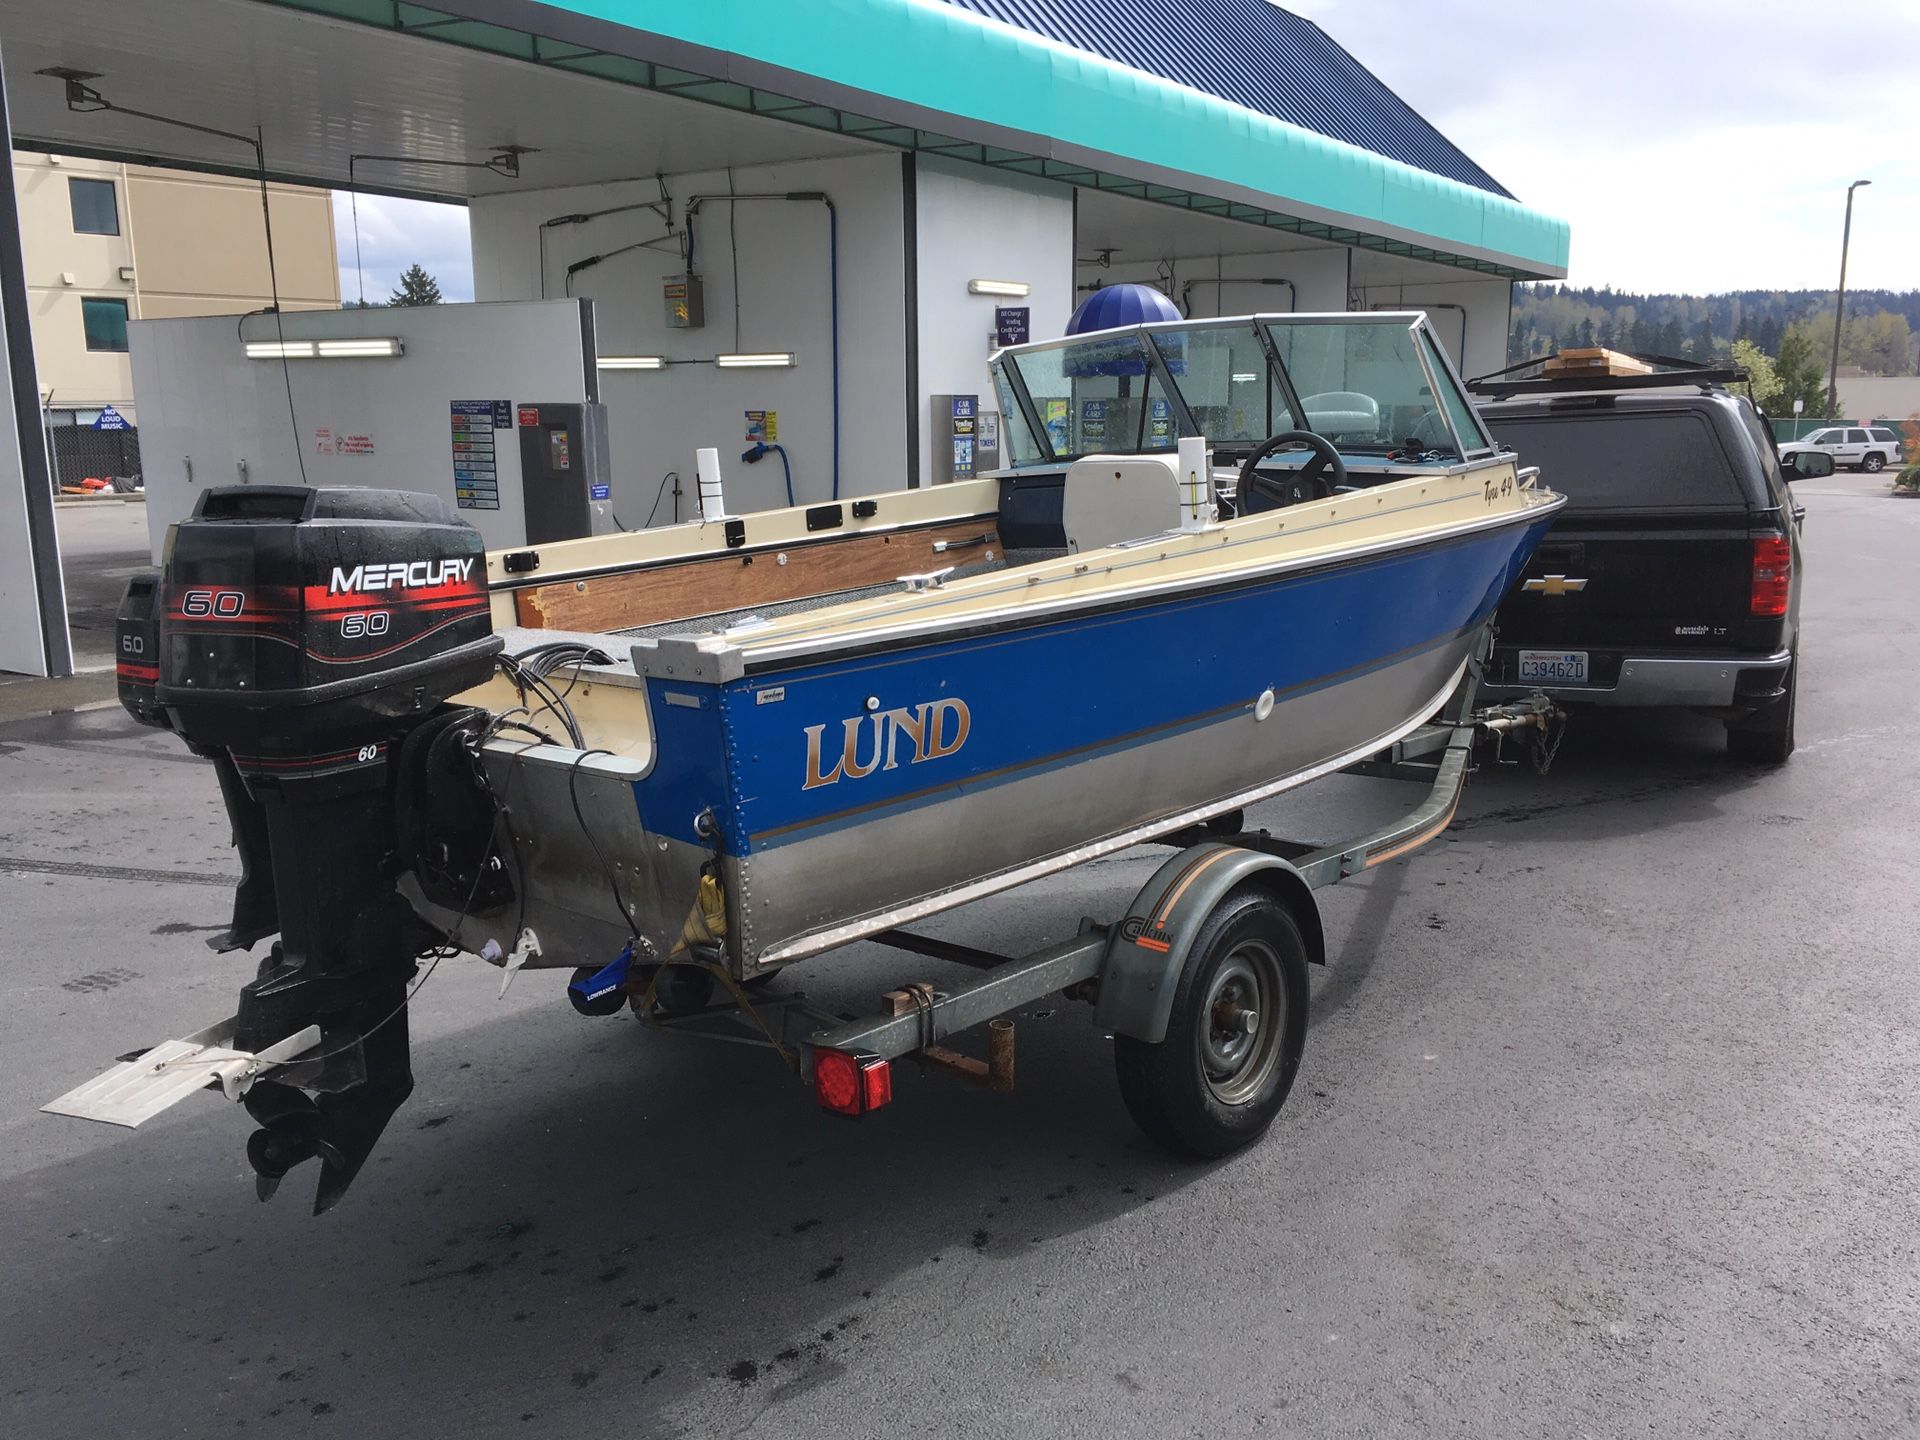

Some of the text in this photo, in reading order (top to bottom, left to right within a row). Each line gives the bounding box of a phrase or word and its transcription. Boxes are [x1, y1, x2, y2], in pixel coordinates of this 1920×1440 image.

[956, 408, 970, 416] CARE
[958, 400, 969, 408] CAR
[101, 415, 121, 423] LOUD
[330, 558, 475, 594] MERCURY
[181, 591, 245, 618] 60
[340, 611, 389, 638] 60
[1522, 661, 1584, 678] C39462D
[357, 744, 377, 761] 60
[802, 698, 971, 791] LUND
